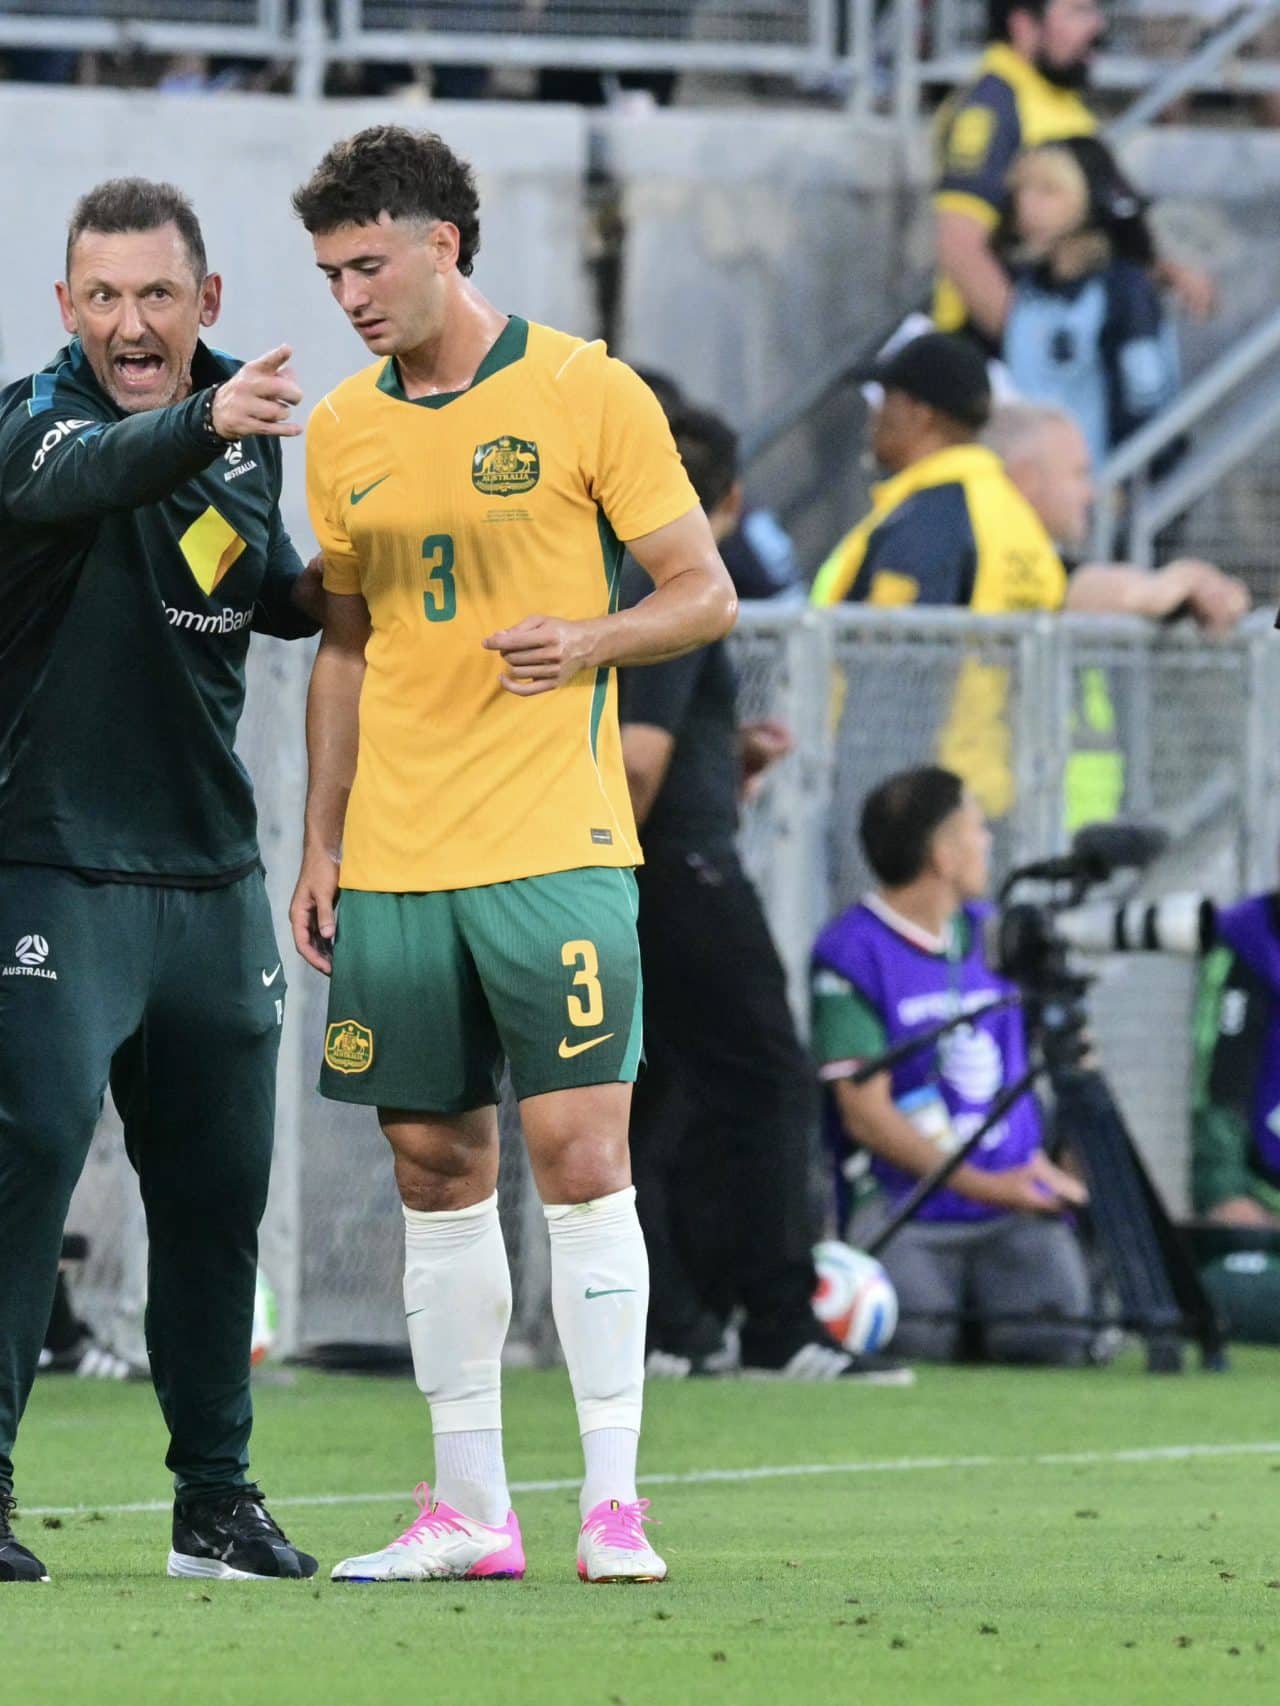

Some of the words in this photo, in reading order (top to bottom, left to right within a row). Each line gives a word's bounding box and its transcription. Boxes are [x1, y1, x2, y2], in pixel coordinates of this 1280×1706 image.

[422, 533, 457, 623] 3
[1, 966, 58, 981] AUSTRALIA
[561, 939, 605, 1028] 3
